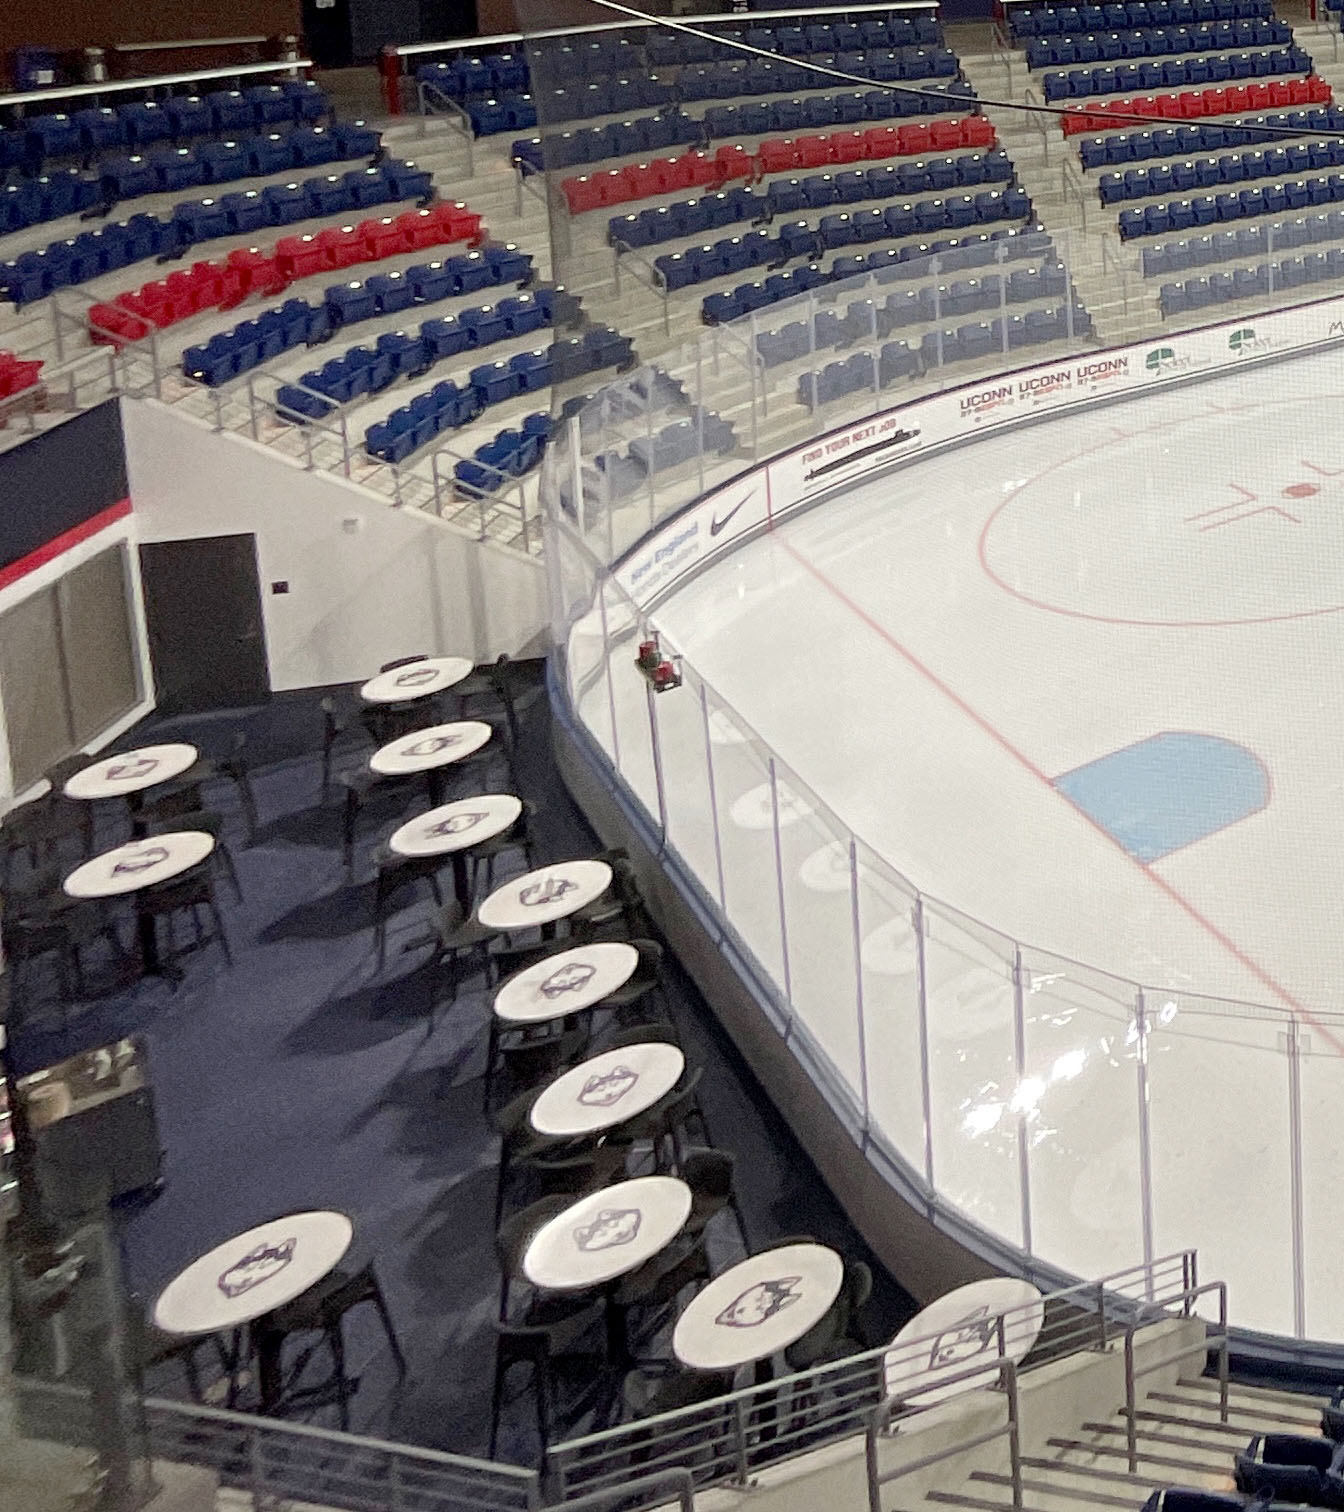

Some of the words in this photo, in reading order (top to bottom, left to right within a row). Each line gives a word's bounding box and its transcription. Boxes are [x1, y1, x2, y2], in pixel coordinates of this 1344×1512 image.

[960, 385, 1012, 410] UCONN
[1018, 370, 1071, 393] UCONN
[1076, 356, 1128, 378] UCONN
[852, 425, 876, 443] NEXT
